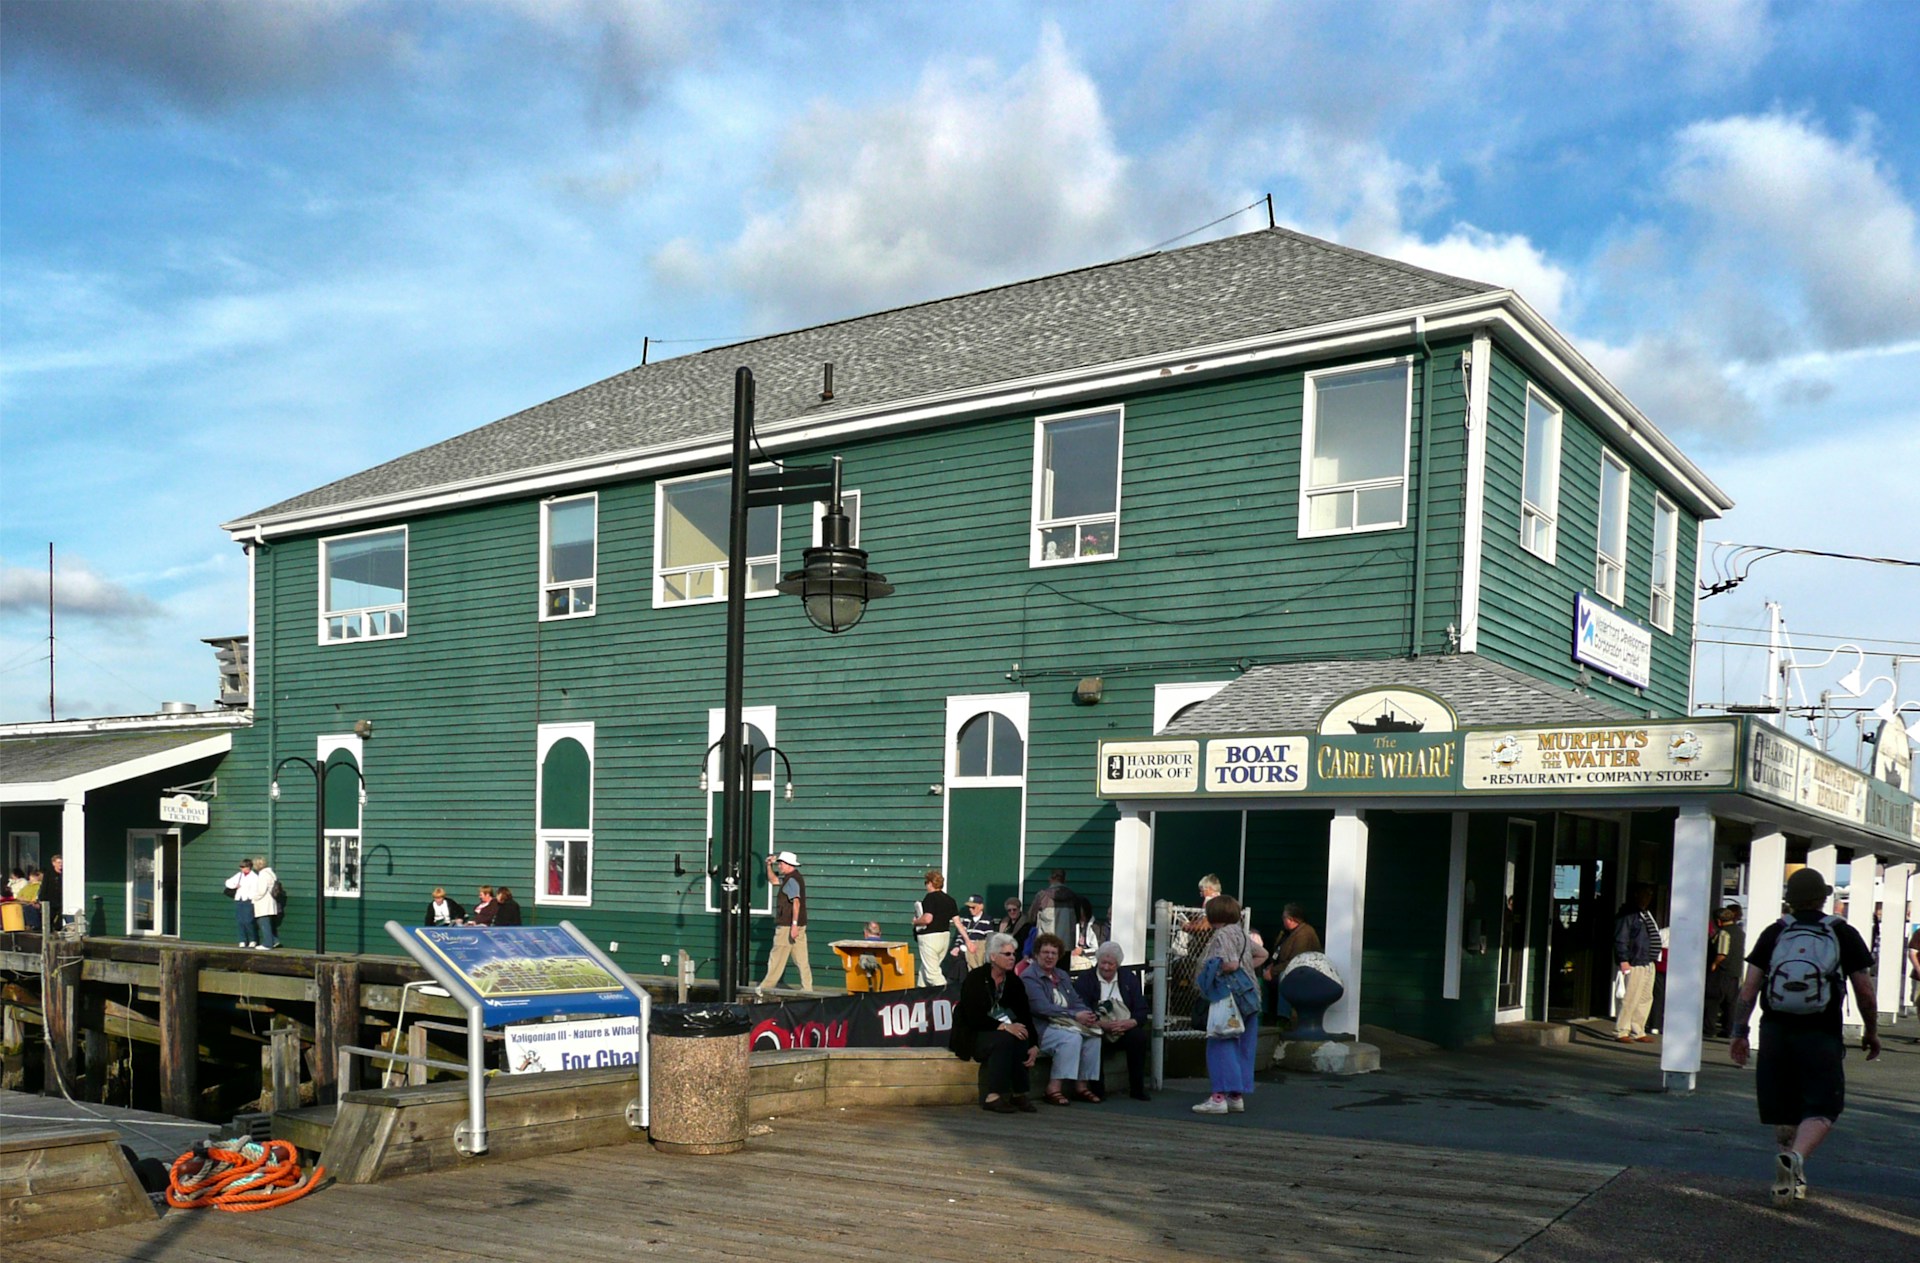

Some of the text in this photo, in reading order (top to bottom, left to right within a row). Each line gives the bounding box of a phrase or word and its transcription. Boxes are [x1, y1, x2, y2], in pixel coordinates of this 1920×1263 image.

[1373, 736, 1397, 748] The
[1538, 730, 1648, 751] MURPHY'S
[1127, 754, 1192, 766] HARBOUR
[1225, 745, 1290, 764] BOAT
[1317, 740, 1456, 779] CABLE WHARF
[1543, 752, 1560, 760] ON
[1563, 750, 1641, 768] WATER
[1541, 760, 1562, 769] THE
[1127, 767, 1192, 779] LOOK OFF
[1215, 764, 1298, 784] TOURS
[1490, 770, 1702, 785] RESTAURANT COMPANY STORE
[163, 805, 206, 815] TOUR BOAT
[169, 813, 201, 821] TICKETS
[878, 999, 958, 1037] 104 D
[558, 1030, 567, 1040] III
[573, 1028, 602, 1039] Nature
[604, 1028, 610, 1037] &
[612, 1025, 640, 1036] Whale
[561, 1052, 591, 1071] For
